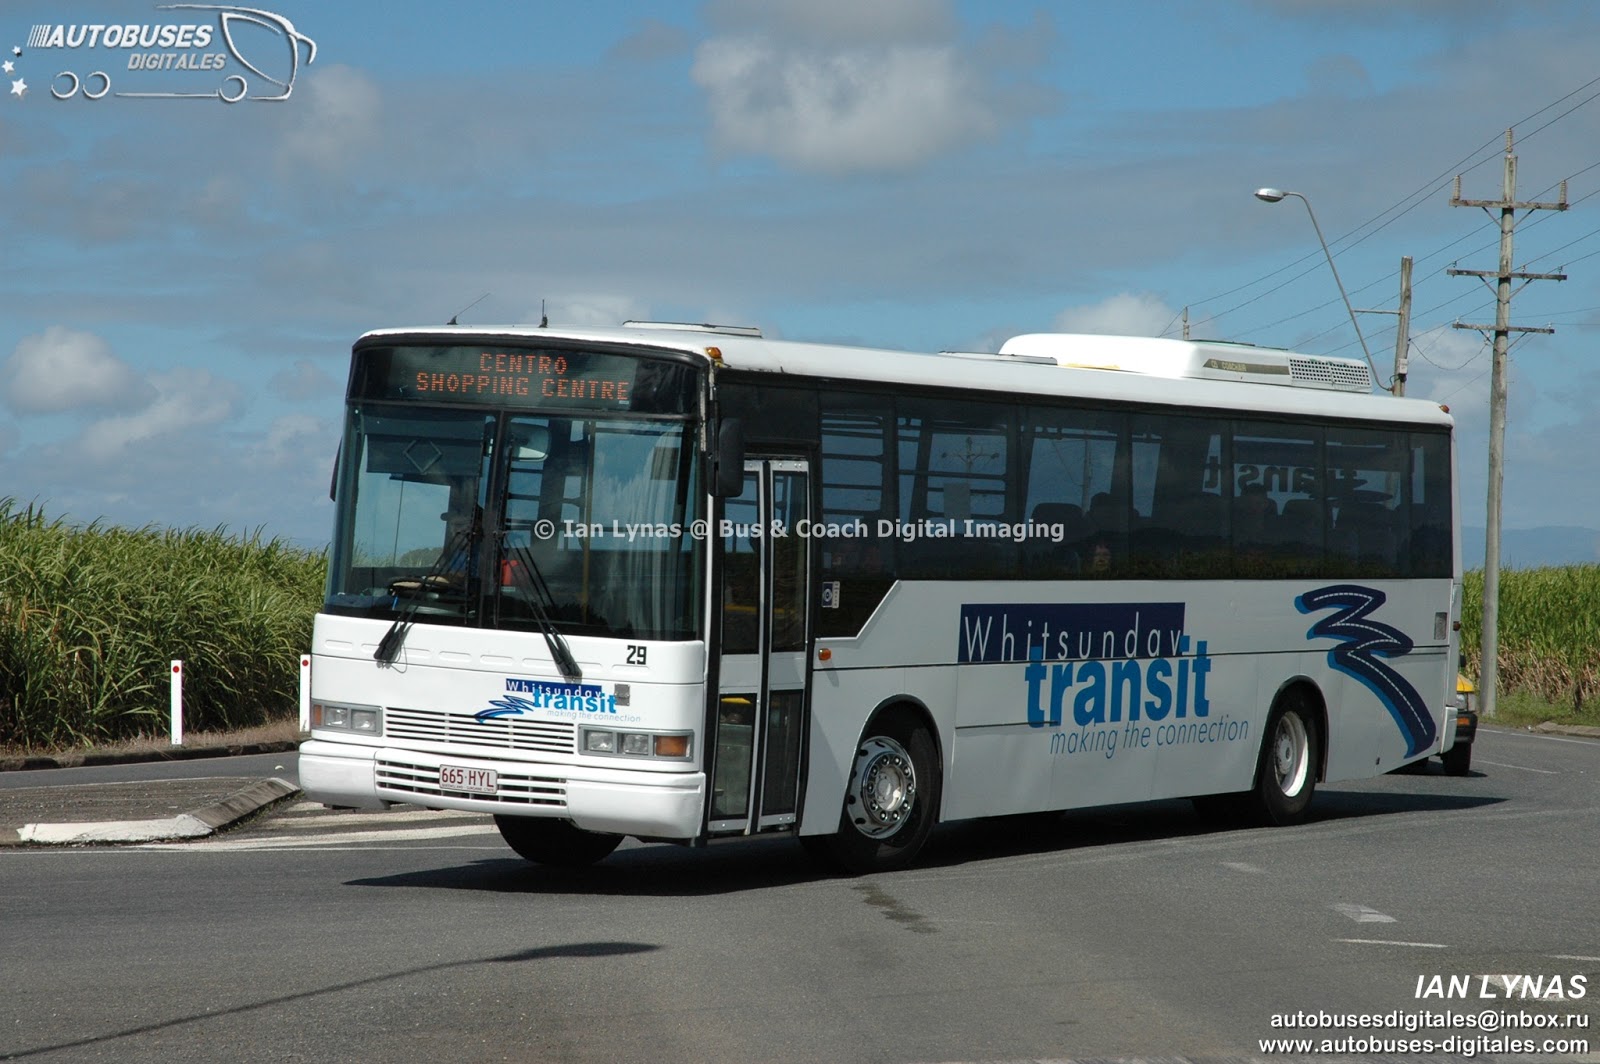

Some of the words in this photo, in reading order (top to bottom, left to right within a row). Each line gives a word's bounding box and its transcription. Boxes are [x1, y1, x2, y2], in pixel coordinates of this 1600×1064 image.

[480, 352, 567, 375] CENTRO
[416, 372, 529, 396] SHOPPING
[541, 378, 630, 400] CENTRE
[626, 645, 647, 665] 29
[1025, 635, 1211, 728] transit
[533, 689, 617, 713] transit
[547, 710, 576, 720] making
[579, 711, 592, 719] the
[594, 712, 641, 722] connection
[1050, 723, 1118, 759] making
[1122, 721, 1151, 748] the
[1156, 714, 1248, 746] connection
